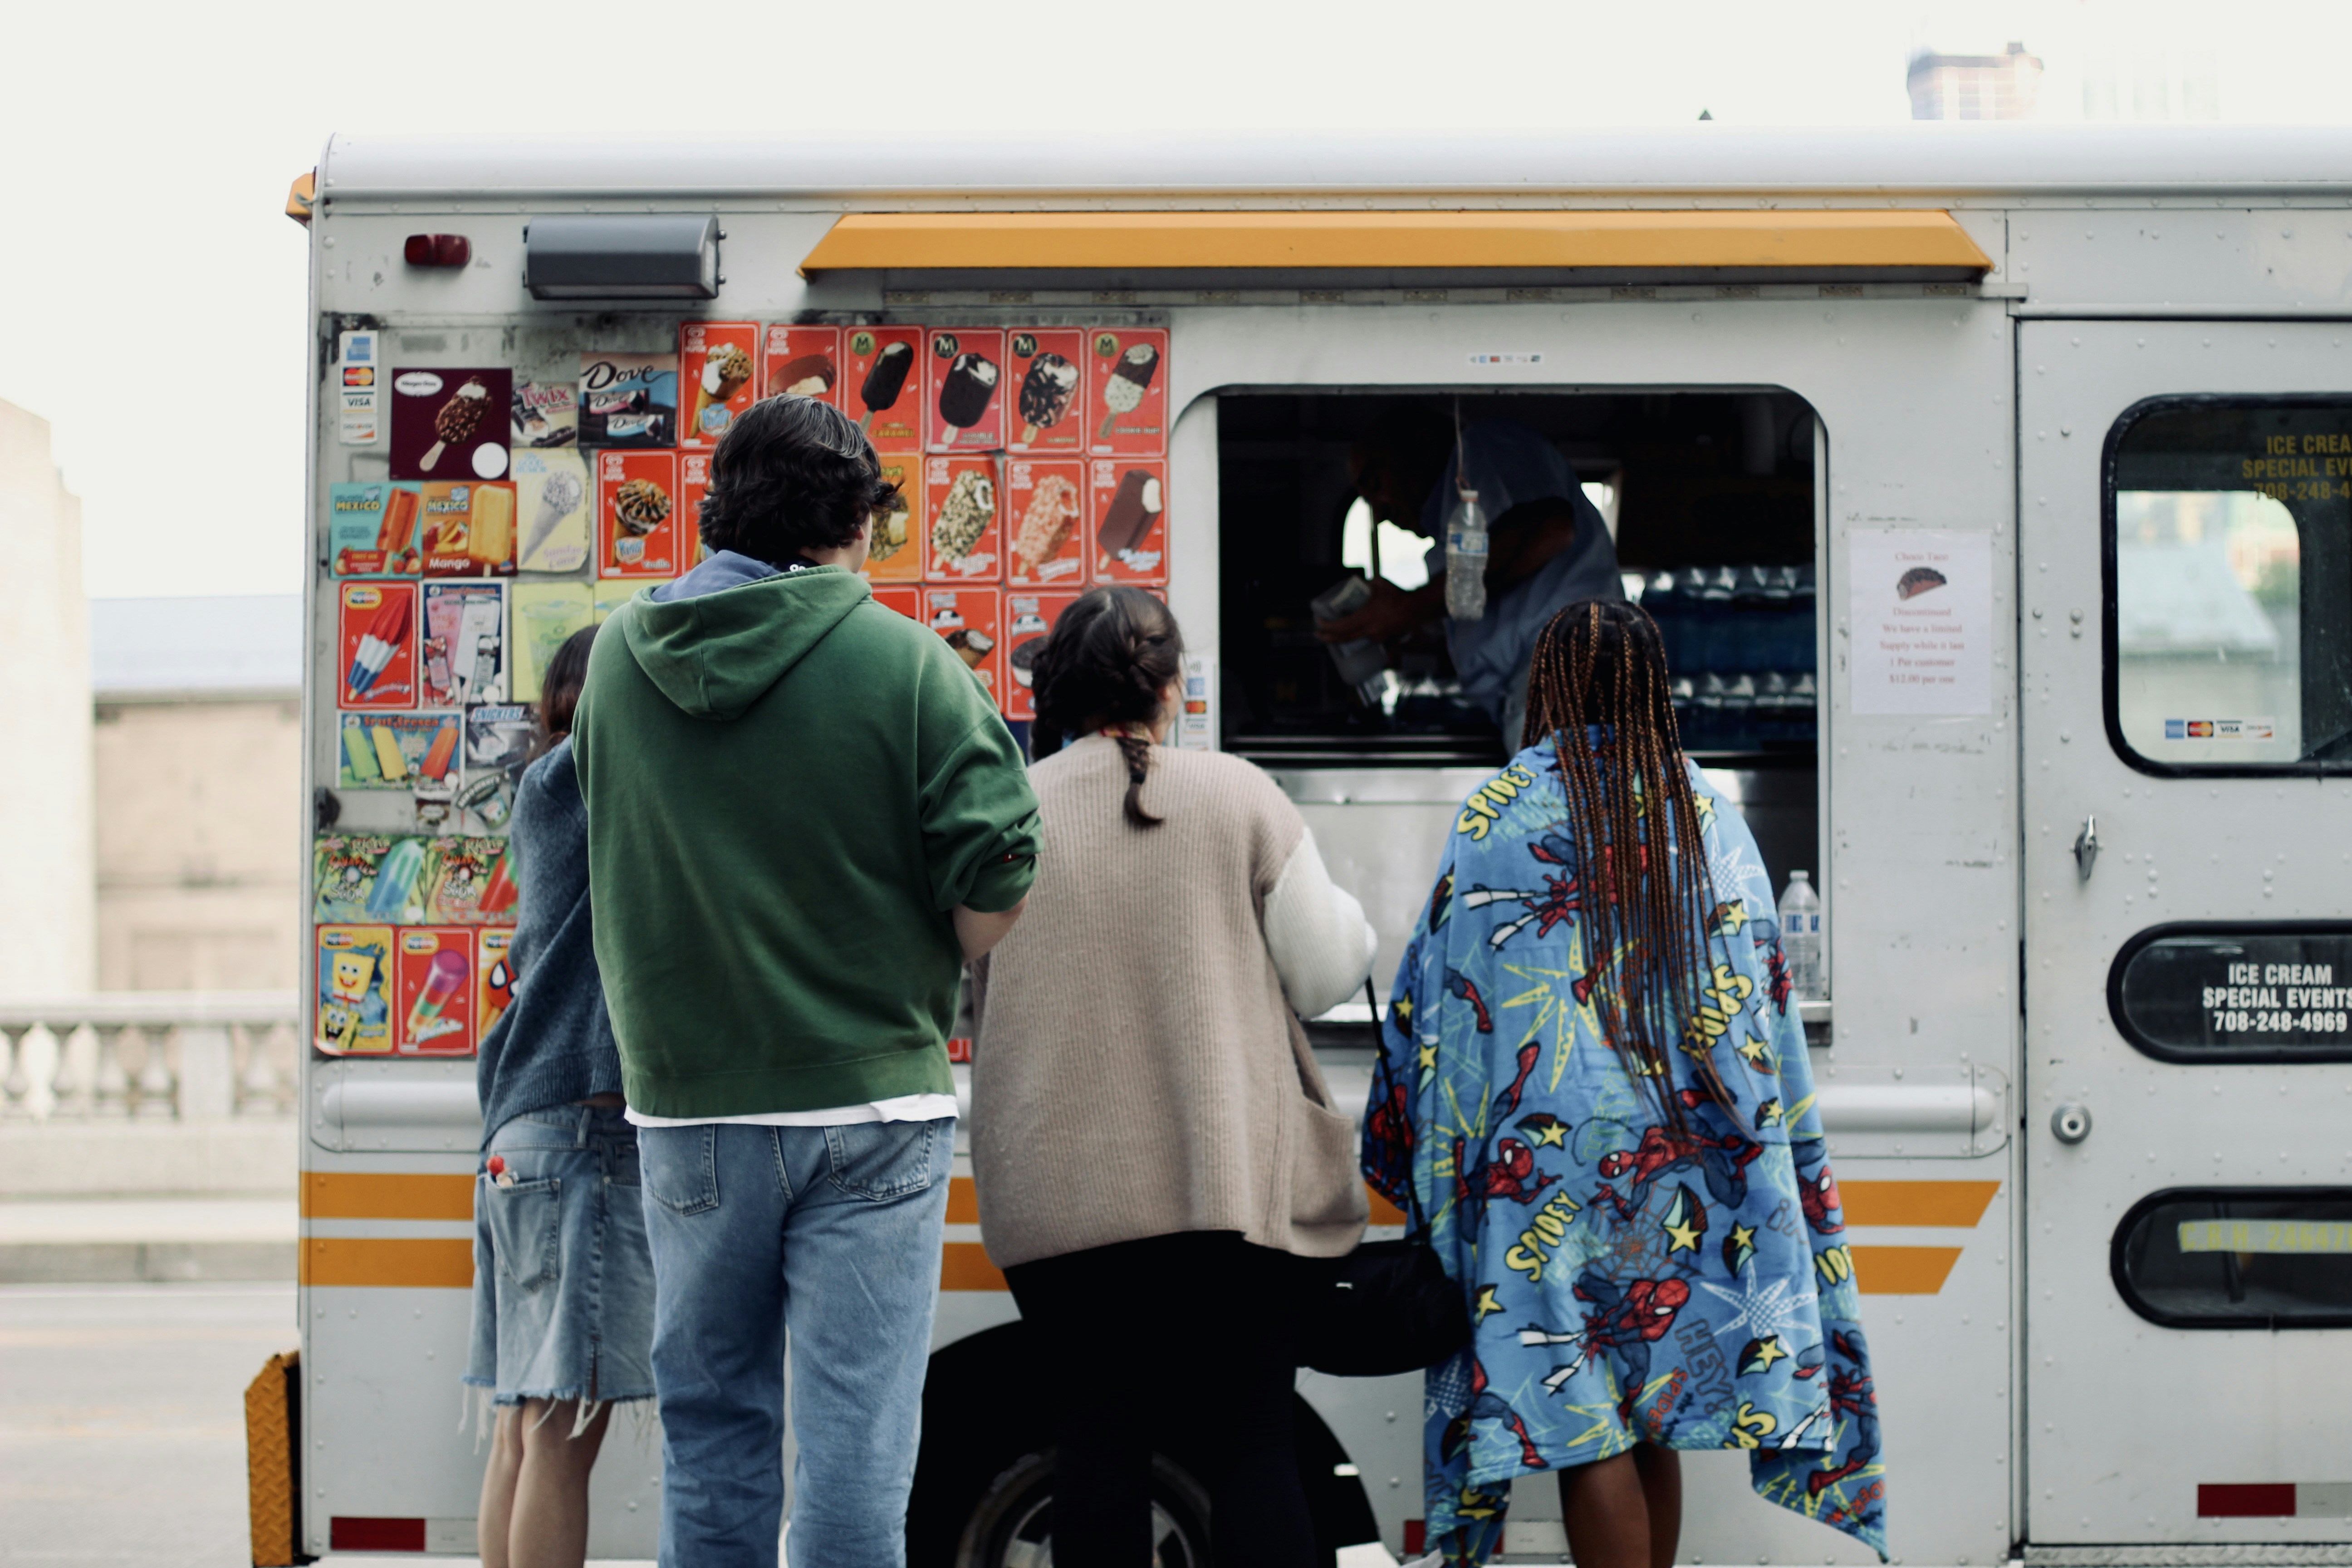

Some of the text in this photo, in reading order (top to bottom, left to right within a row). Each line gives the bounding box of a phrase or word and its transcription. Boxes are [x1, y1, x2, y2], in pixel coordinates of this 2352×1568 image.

[583, 361, 668, 389] Dove
[348, 398, 371, 407] VISA
[516, 387, 570, 409] Twix
[2267, 436, 2296, 455] ICE
[2242, 457, 2352, 478] SPECIAL EV
[336, 501, 380, 512] MEXICO
[429, 558, 471, 571] Mango
[473, 707, 523, 722] SNICKERS
[1456, 762, 1539, 842] SPIDEY
[2228, 964, 2332, 985] ICE CREAM
[2202, 987, 2282, 1009] SPECIAL
[2213, 1010, 2347, 1032] 708-248-4969
[1505, 1188, 1583, 1284] SPIDEY
[2268, 1224, 2352, 1250] 24647
[1675, 1318, 1738, 1415] HEY!
